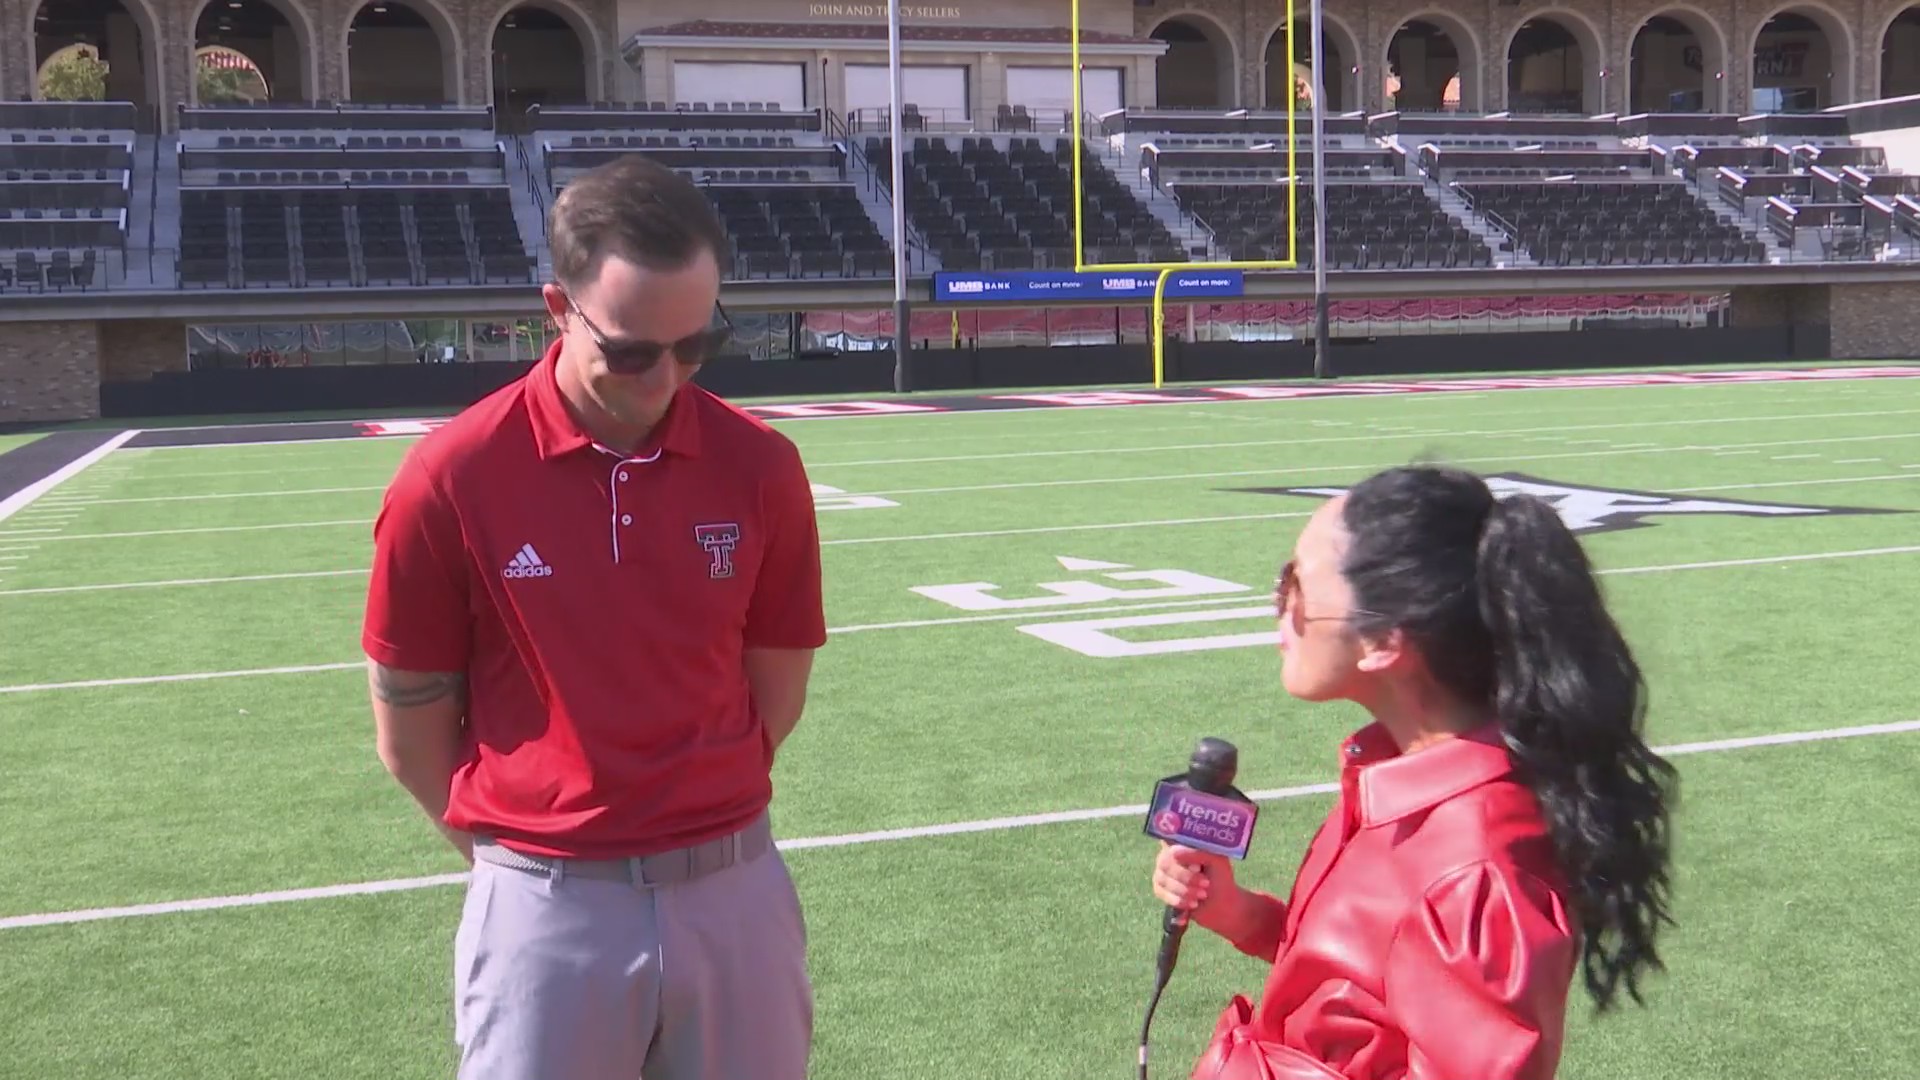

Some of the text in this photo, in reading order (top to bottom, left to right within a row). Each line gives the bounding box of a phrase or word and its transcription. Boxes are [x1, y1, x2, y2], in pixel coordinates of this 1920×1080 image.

[809, 4, 961, 18] JOHN AND TCY SELLERS
[949, 281, 1011, 293] UMB BANK
[1028, 281, 1050, 289] Count
[1102, 279, 1157, 290] UMB BAN
[1178, 279, 1200, 287] Count
[503, 564, 552, 578] adidas
[1158, 812, 1237, 843] & friends
